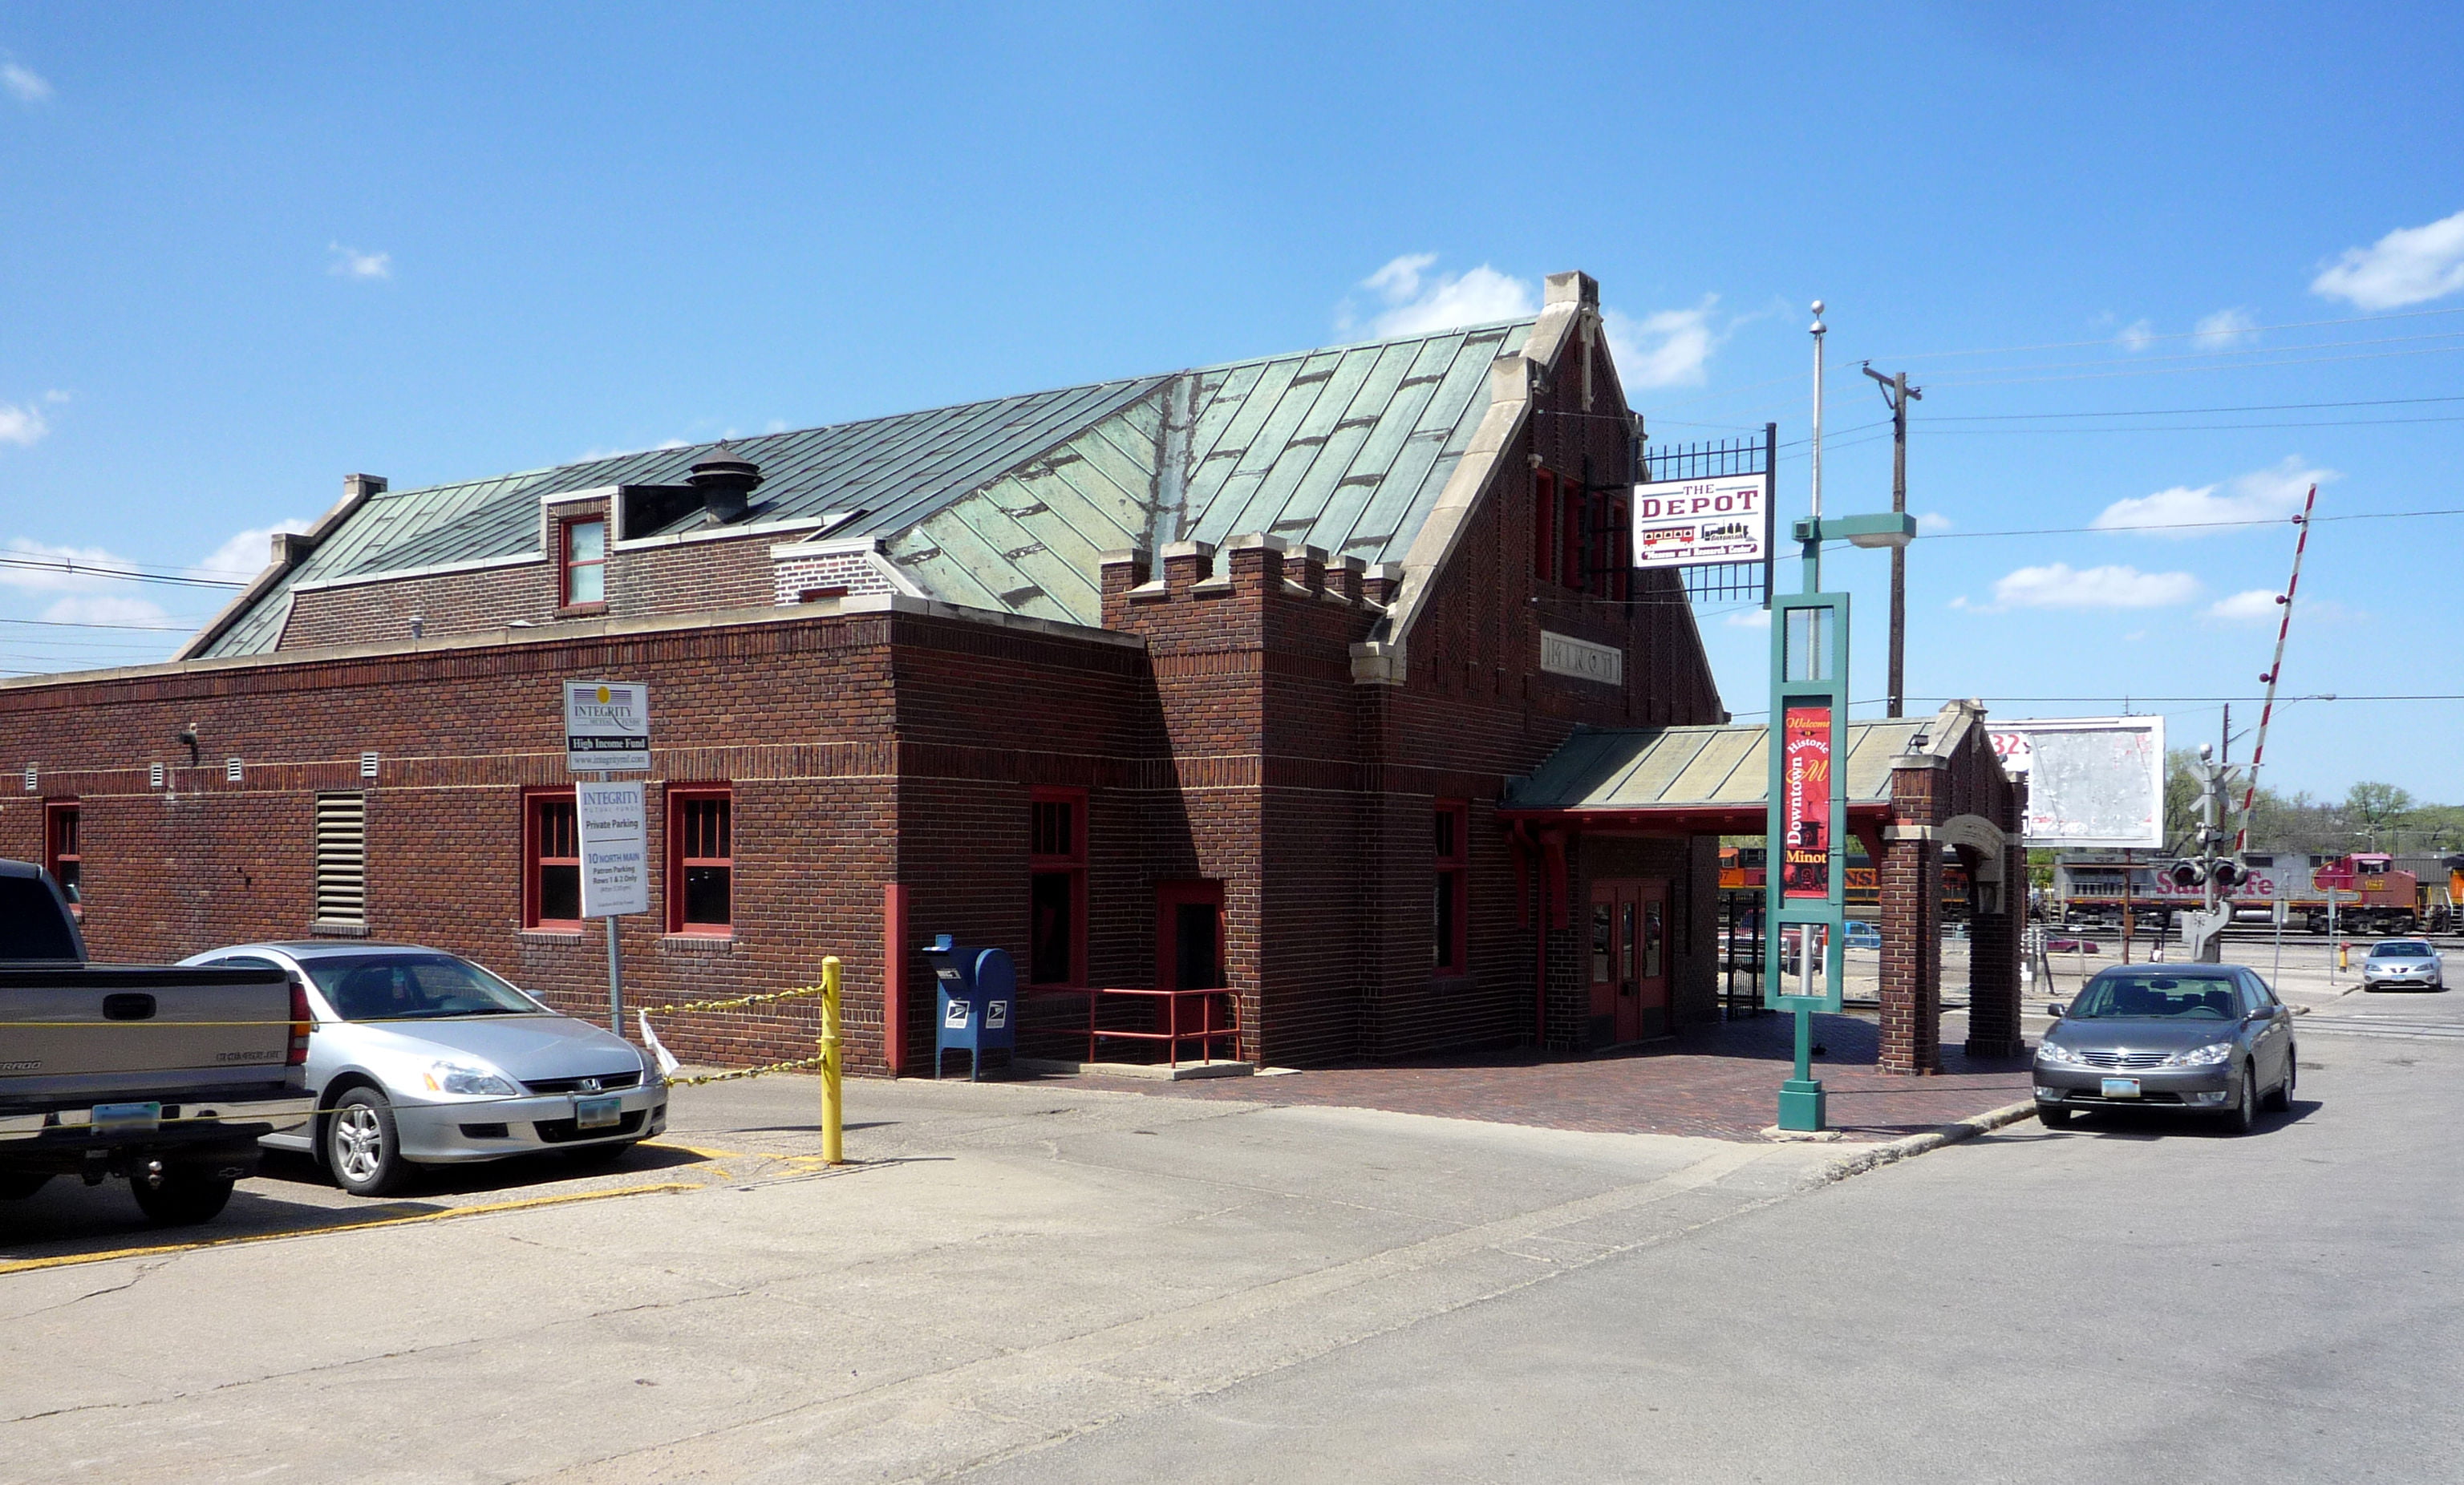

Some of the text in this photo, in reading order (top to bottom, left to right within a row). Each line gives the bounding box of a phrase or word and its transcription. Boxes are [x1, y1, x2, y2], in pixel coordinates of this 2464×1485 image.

[1684, 484, 1715, 495] THE
[1642, 490, 1758, 518] DEPOT
[574, 706, 631, 717] INTEGRITY
[1786, 718, 1830, 728] Welcome
[573, 738, 645, 751] High Income Fund
[1787, 738, 1830, 755] Historic
[584, 791, 640, 805] INTEGRITY
[1787, 757, 1802, 845] Downtown
[586, 819, 638, 830] Private Parking
[588, 853, 639, 864] 10 NORTH MAIN
[1786, 850, 1826, 864] Minot
[614, 865, 635, 873] Parking
